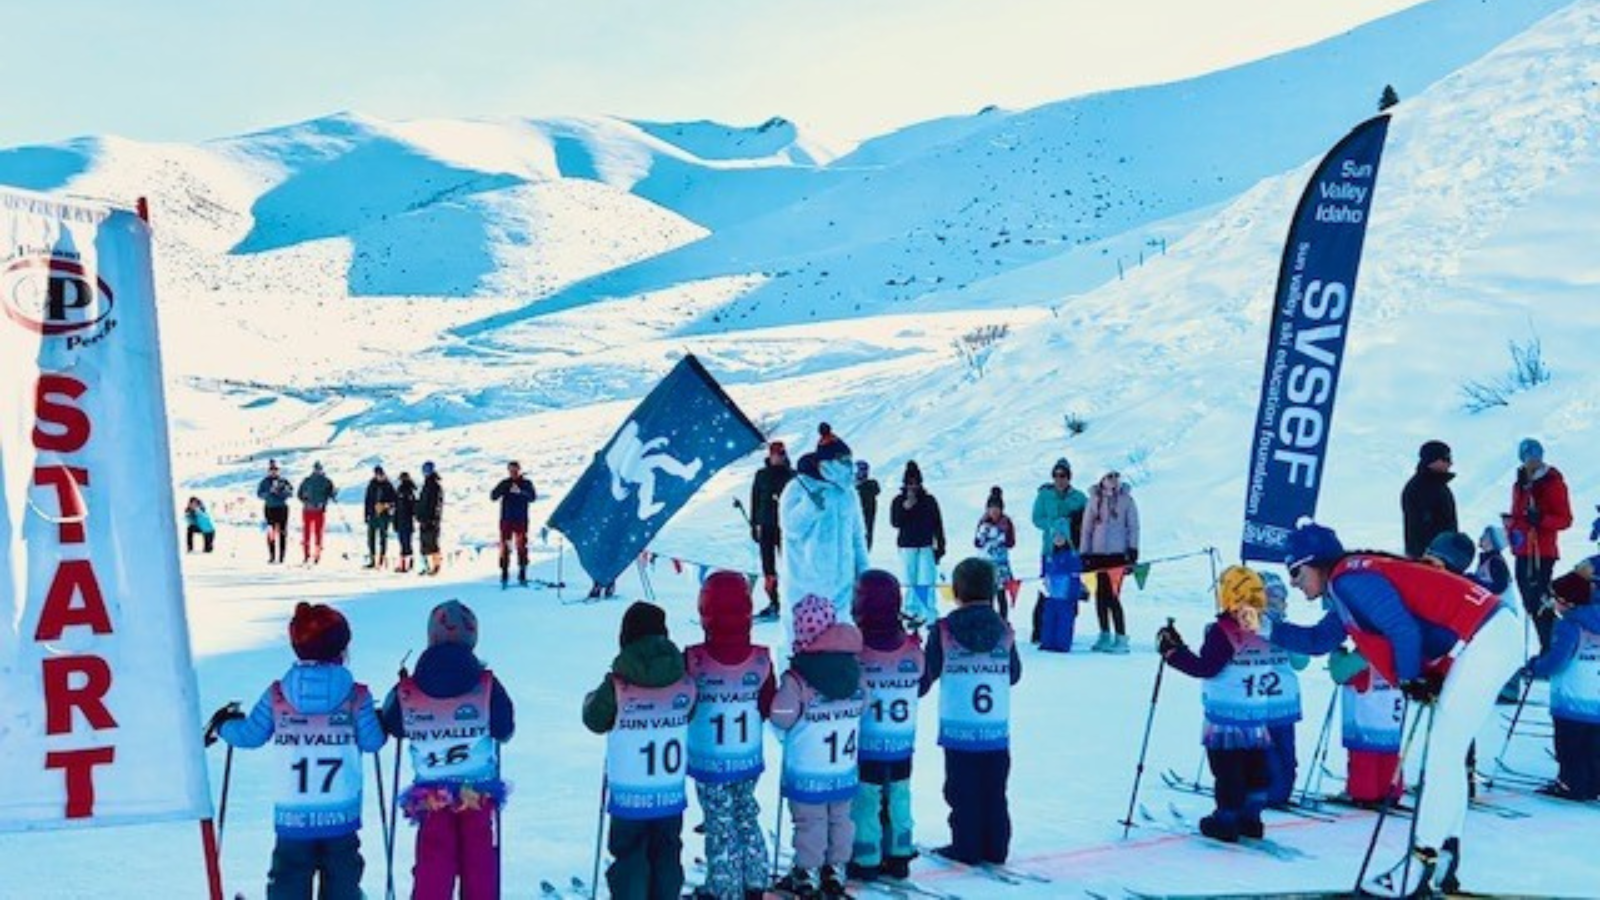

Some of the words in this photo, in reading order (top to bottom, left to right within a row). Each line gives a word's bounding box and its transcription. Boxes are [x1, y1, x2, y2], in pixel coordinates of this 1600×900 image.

[1341, 160, 1373, 178] Sun
[1320, 181, 1368, 204] Valley
[1315, 204, 1363, 223] Idaho
[46, 276, 93, 321] P
[1282, 274, 1303, 318] valley
[1278, 321, 1294, 346] ski
[1262, 349, 1288, 427] education
[1246, 429, 1275, 515] foundation
[32, 373, 119, 819] START
[972, 683, 994, 715] 6
[709, 711, 748, 746] 11
[824, 728, 856, 764] 14
[291, 756, 344, 794] 17
[639, 738, 682, 776] 10
